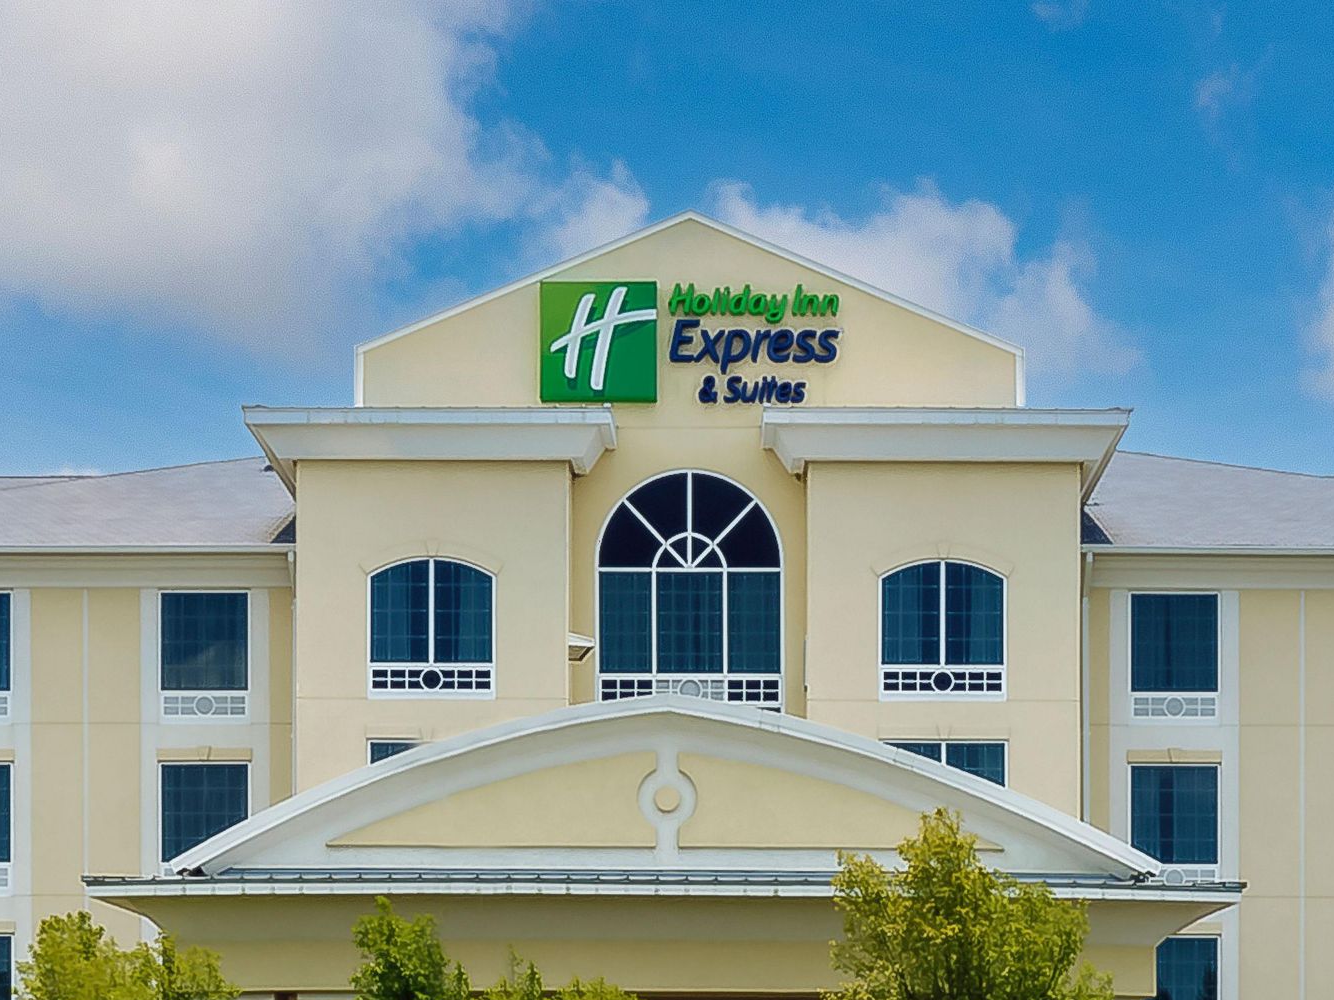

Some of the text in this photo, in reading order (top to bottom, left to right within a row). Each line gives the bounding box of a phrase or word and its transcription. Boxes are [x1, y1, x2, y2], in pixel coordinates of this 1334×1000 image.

[668, 283, 839, 324] Holiday Inn
[669, 319, 840, 374] Express
[698, 375, 806, 404] & Suites
